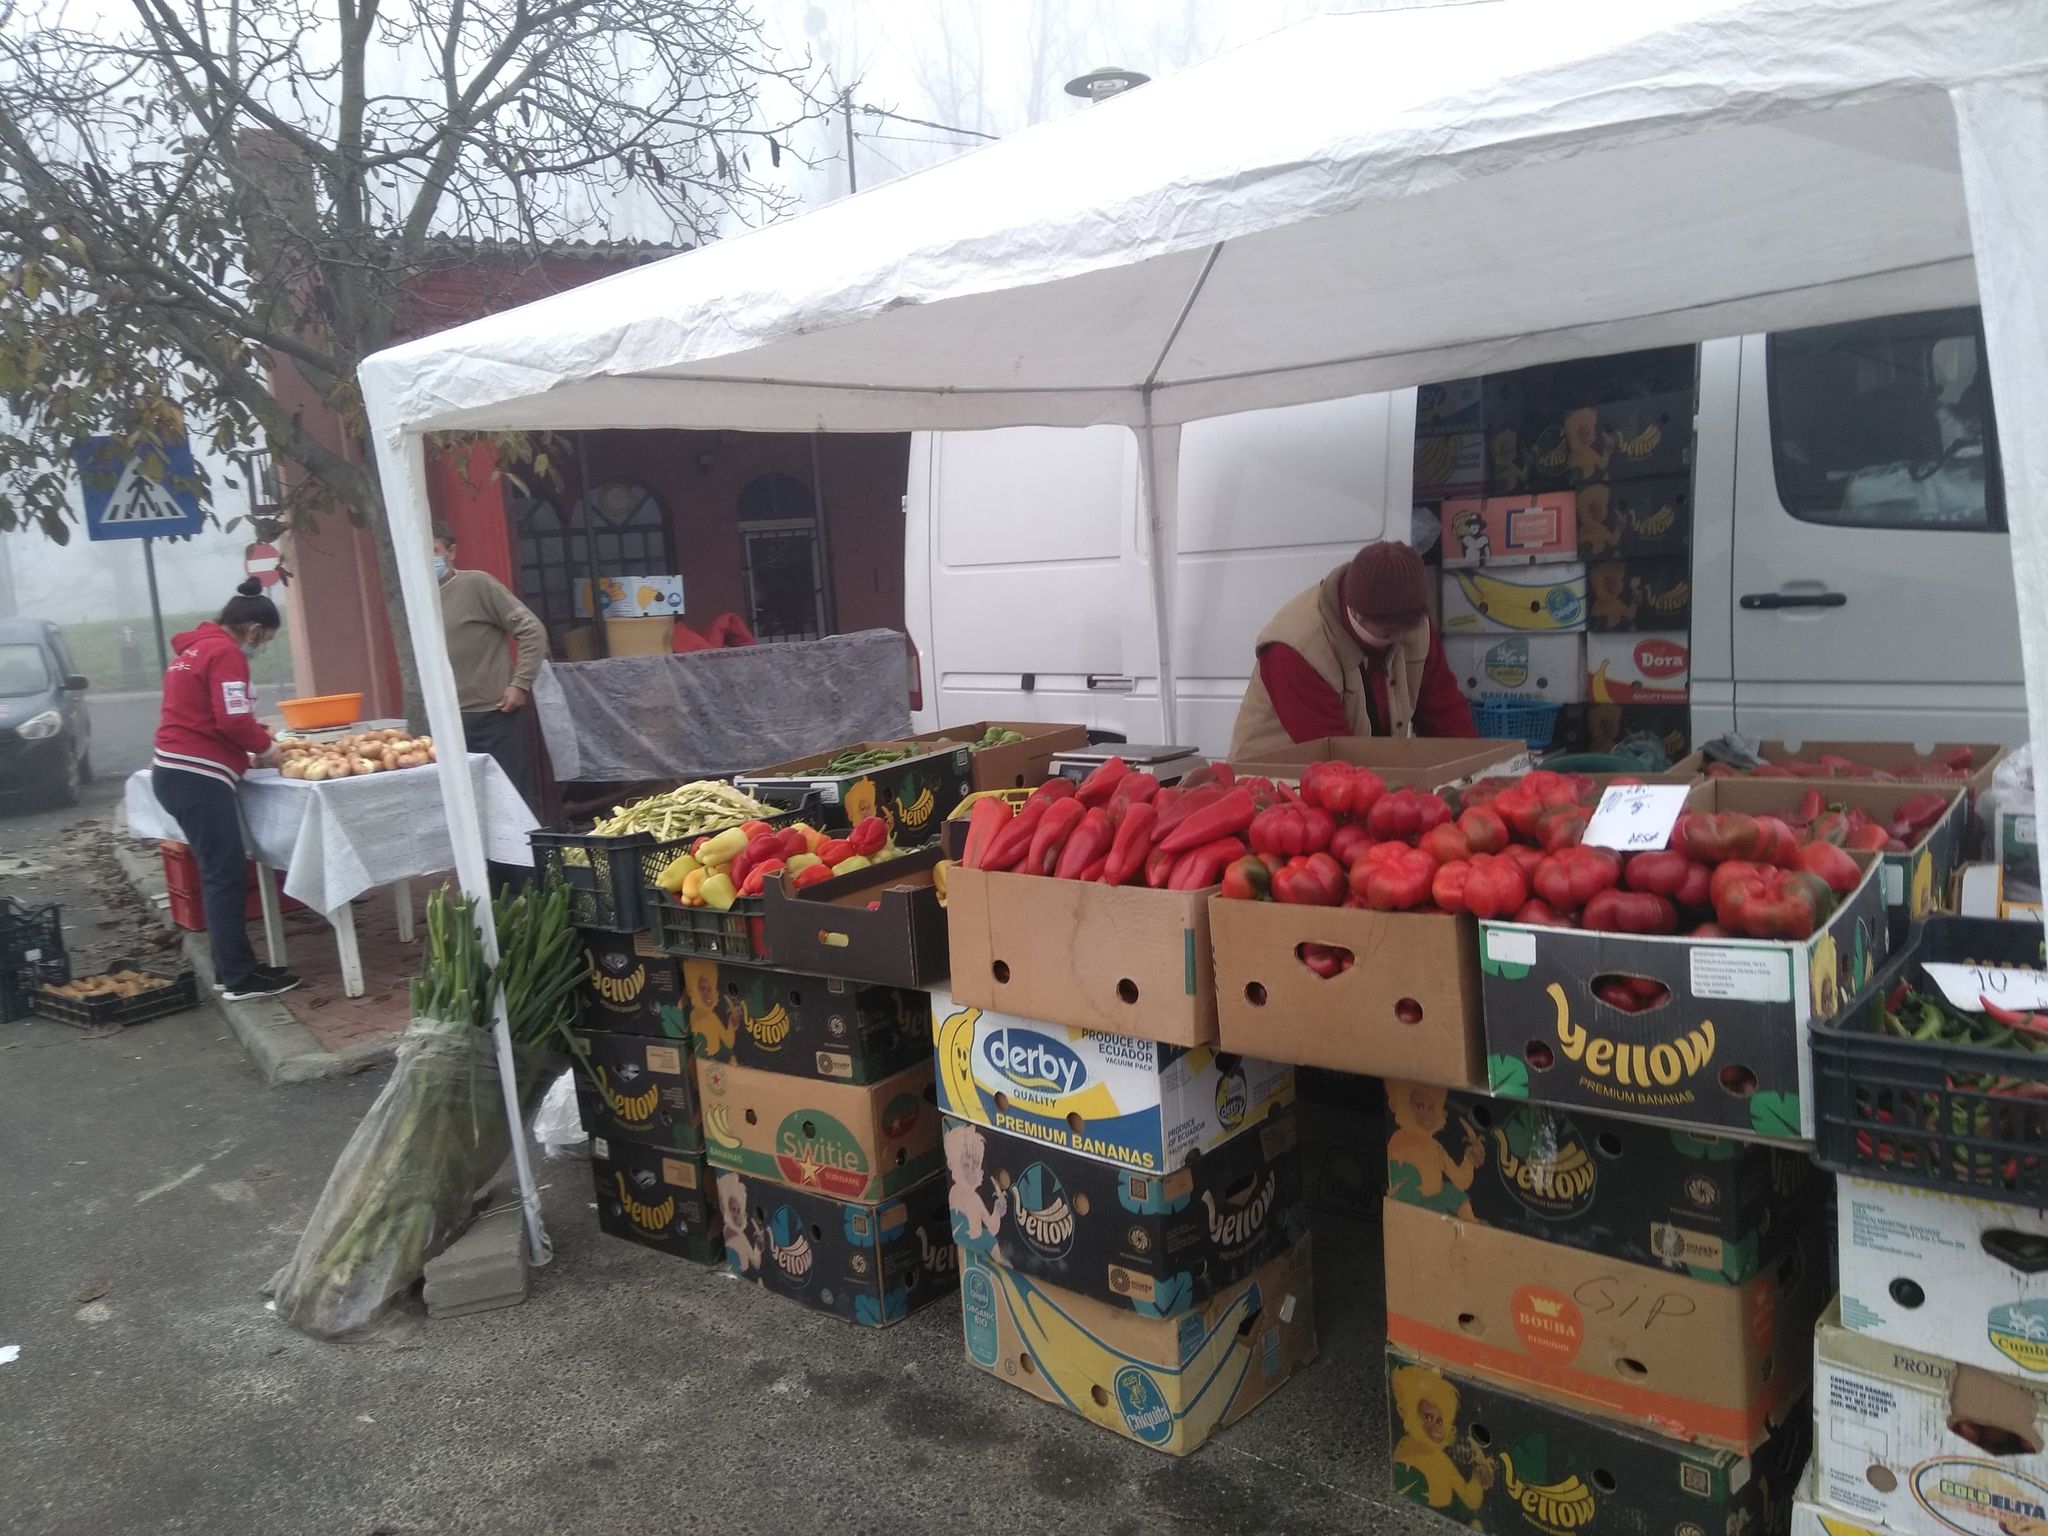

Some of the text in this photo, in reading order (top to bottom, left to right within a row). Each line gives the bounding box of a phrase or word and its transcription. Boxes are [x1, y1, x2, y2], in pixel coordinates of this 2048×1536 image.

[1641, 652, 1684, 667] Dora
[895, 794, 934, 826] yellow
[584, 948, 645, 1002] yellow
[1977, 968, 2007, 993] 10
[740, 999, 790, 1044] yellow
[1546, 982, 1716, 1088] yellow
[1082, 1028, 1153, 1051] PRODUCE OF
[1098, 1043, 1153, 1063] ECUADOR
[990, 1027, 1078, 1095] derby
[1105, 1056, 1153, 1072] VACUUM PACK
[596, 1065, 660, 1121] yellow
[1013, 1088, 1057, 1109] QUALITY
[1579, 1075, 1696, 1106] PREMIUM BANANAS
[1220, 1097, 1245, 1119] derby
[996, 1112, 1154, 1169] PREMIUM BANANAS
[1168, 1117, 1195, 1138] PRODUCE
[1177, 1121, 1206, 1144] ECUADOR
[783, 1131, 859, 1170] Switie
[1494, 1127, 1594, 1200] yellow
[615, 1171, 676, 1230] yellow
[1011, 1185, 1073, 1245] yellow
[1201, 1169, 1275, 1246] yellow
[766, 1225, 812, 1275] yellow
[966, 1303, 995, 1322] ORGANIC
[974, 1315, 988, 1328] BIO
[1519, 1312, 1576, 1338] BOUBA
[1126, 1403, 1171, 1433] Chiquita
[1499, 1451, 1595, 1528] yellow
